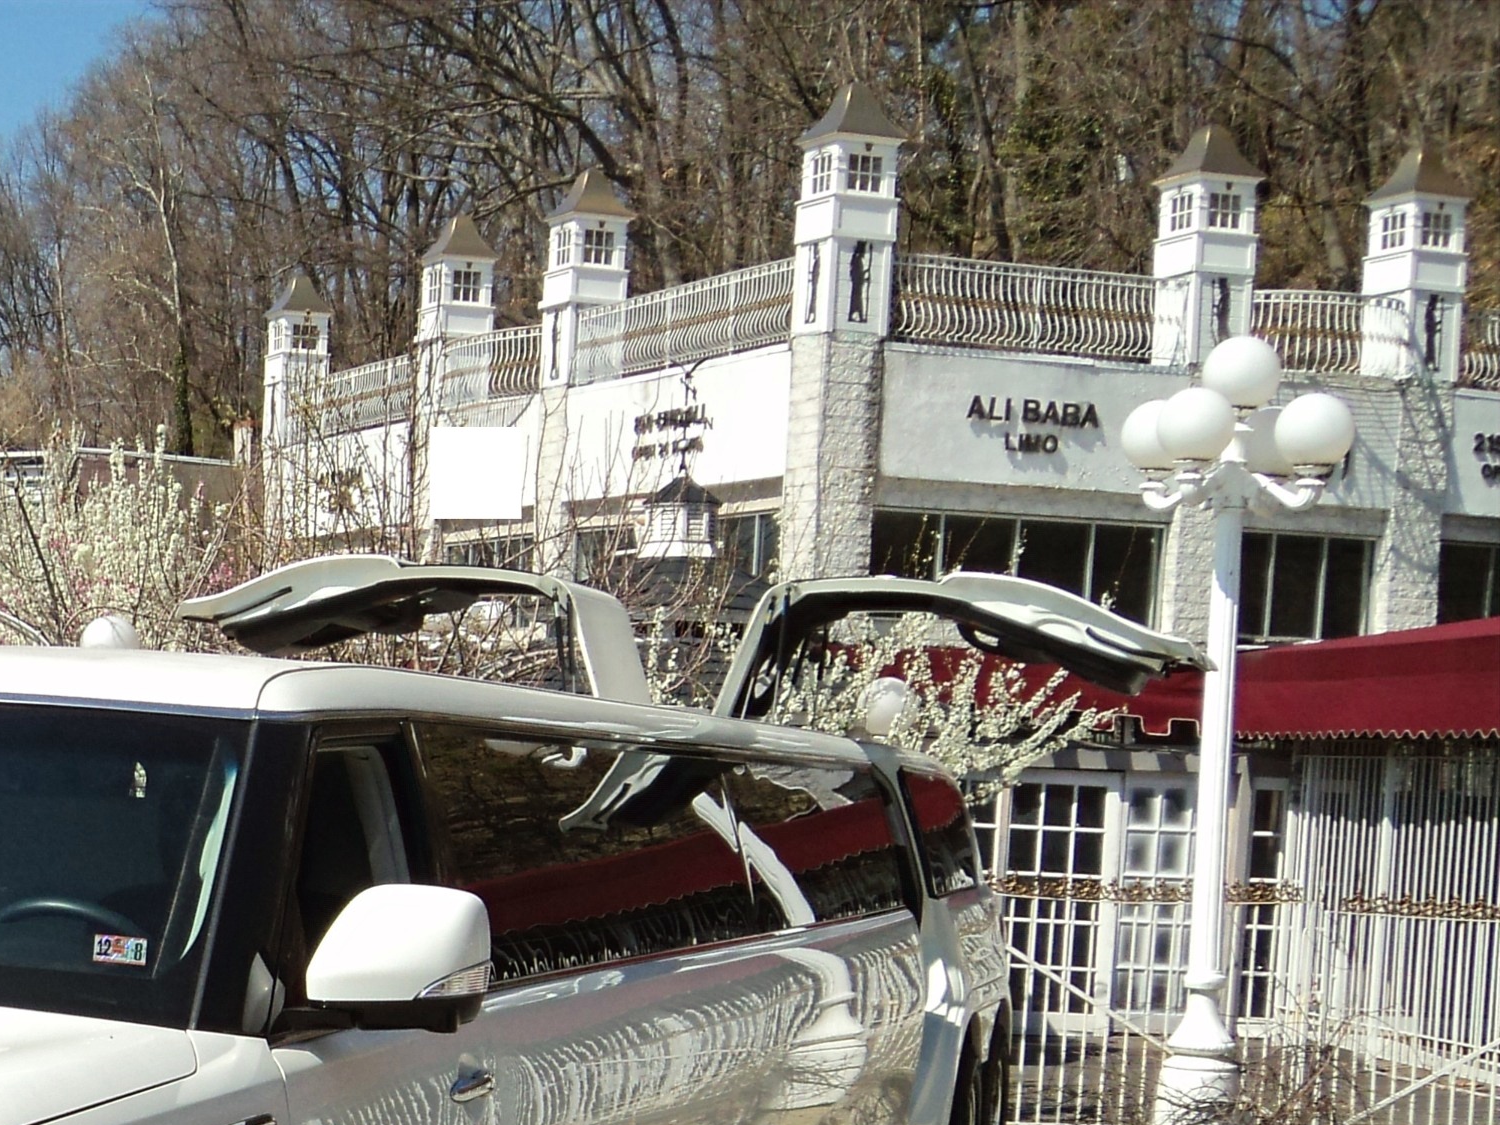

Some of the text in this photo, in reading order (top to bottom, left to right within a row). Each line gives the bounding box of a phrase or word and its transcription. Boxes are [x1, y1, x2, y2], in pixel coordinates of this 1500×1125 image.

[966, 395, 1099, 428] ALI BABA
[1005, 432, 1059, 453] LIMO
[96, 938, 111, 956] 12
